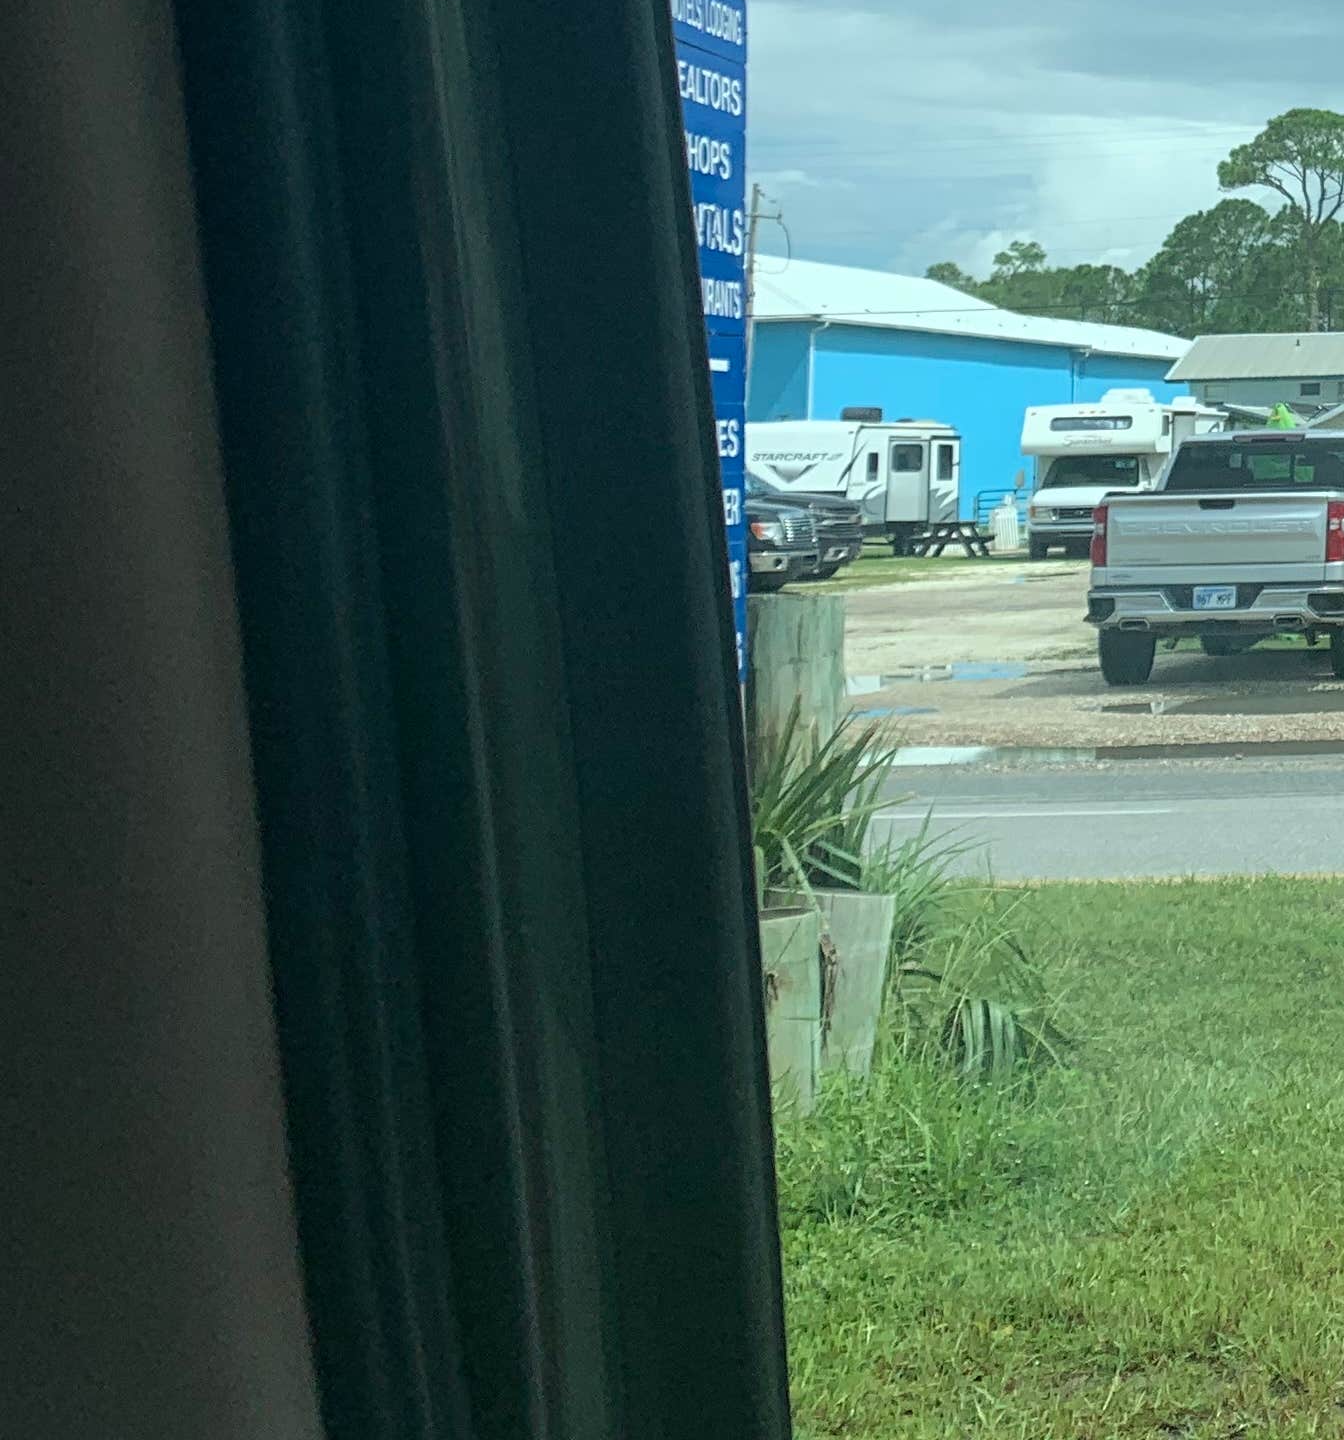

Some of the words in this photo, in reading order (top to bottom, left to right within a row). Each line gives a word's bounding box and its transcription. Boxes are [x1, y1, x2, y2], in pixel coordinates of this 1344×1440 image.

[678, 60, 742, 116] EALTORS
[684, 130, 731, 180] HOPS
[752, 452, 828, 462] STARCRAFT
